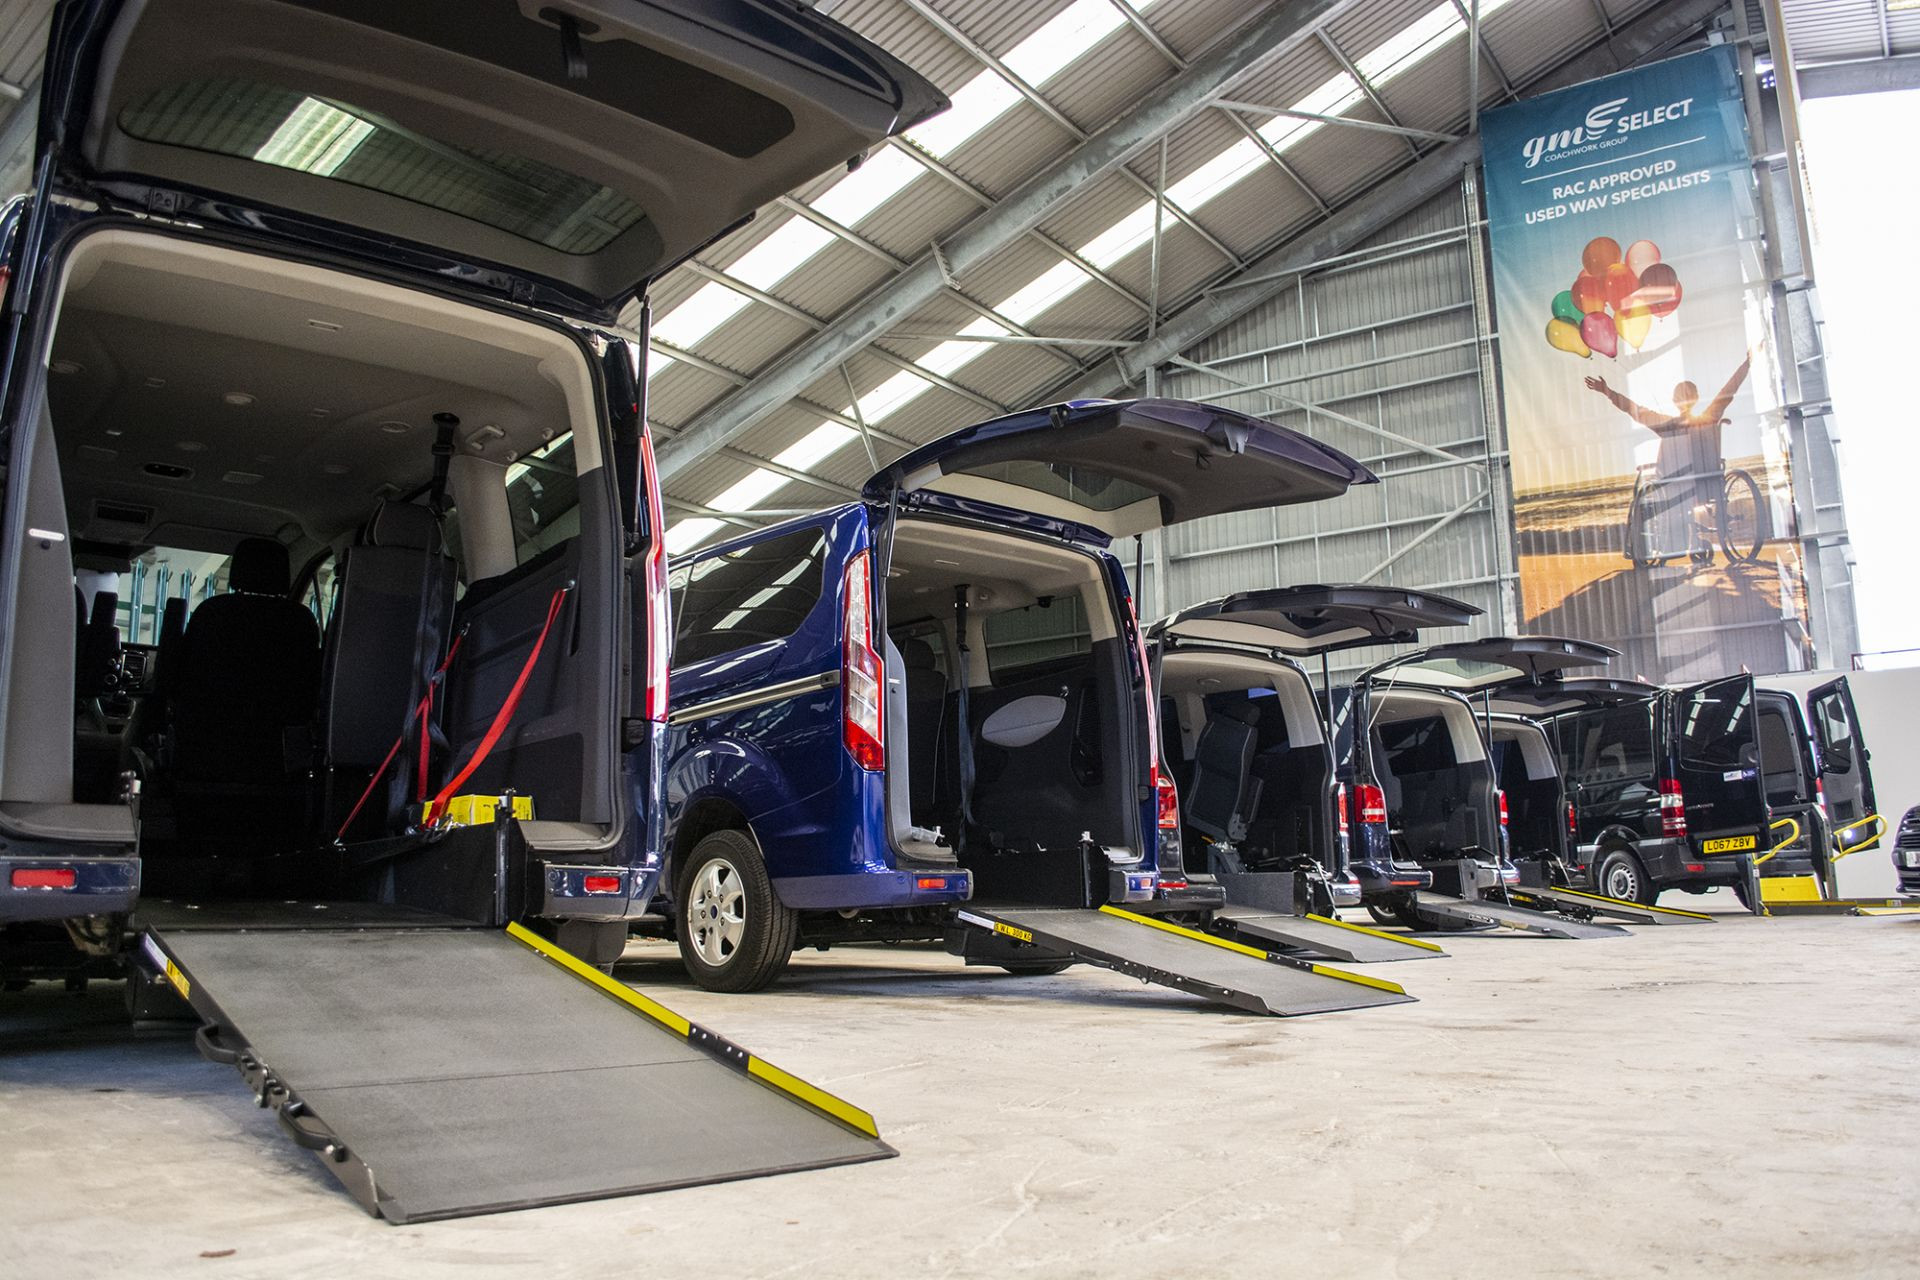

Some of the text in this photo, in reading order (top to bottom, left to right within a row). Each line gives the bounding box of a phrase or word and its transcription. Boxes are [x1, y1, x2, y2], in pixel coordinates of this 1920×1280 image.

[1617, 98, 1693, 133] SELECT
[1544, 136, 1628, 162] COACHWORK GROUP
[1553, 159, 1676, 199] RAC APPROVED
[1525, 170, 1711, 224] USED WAV SPECIALISTS
[1707, 837, 1750, 850] LO67 ZBV
